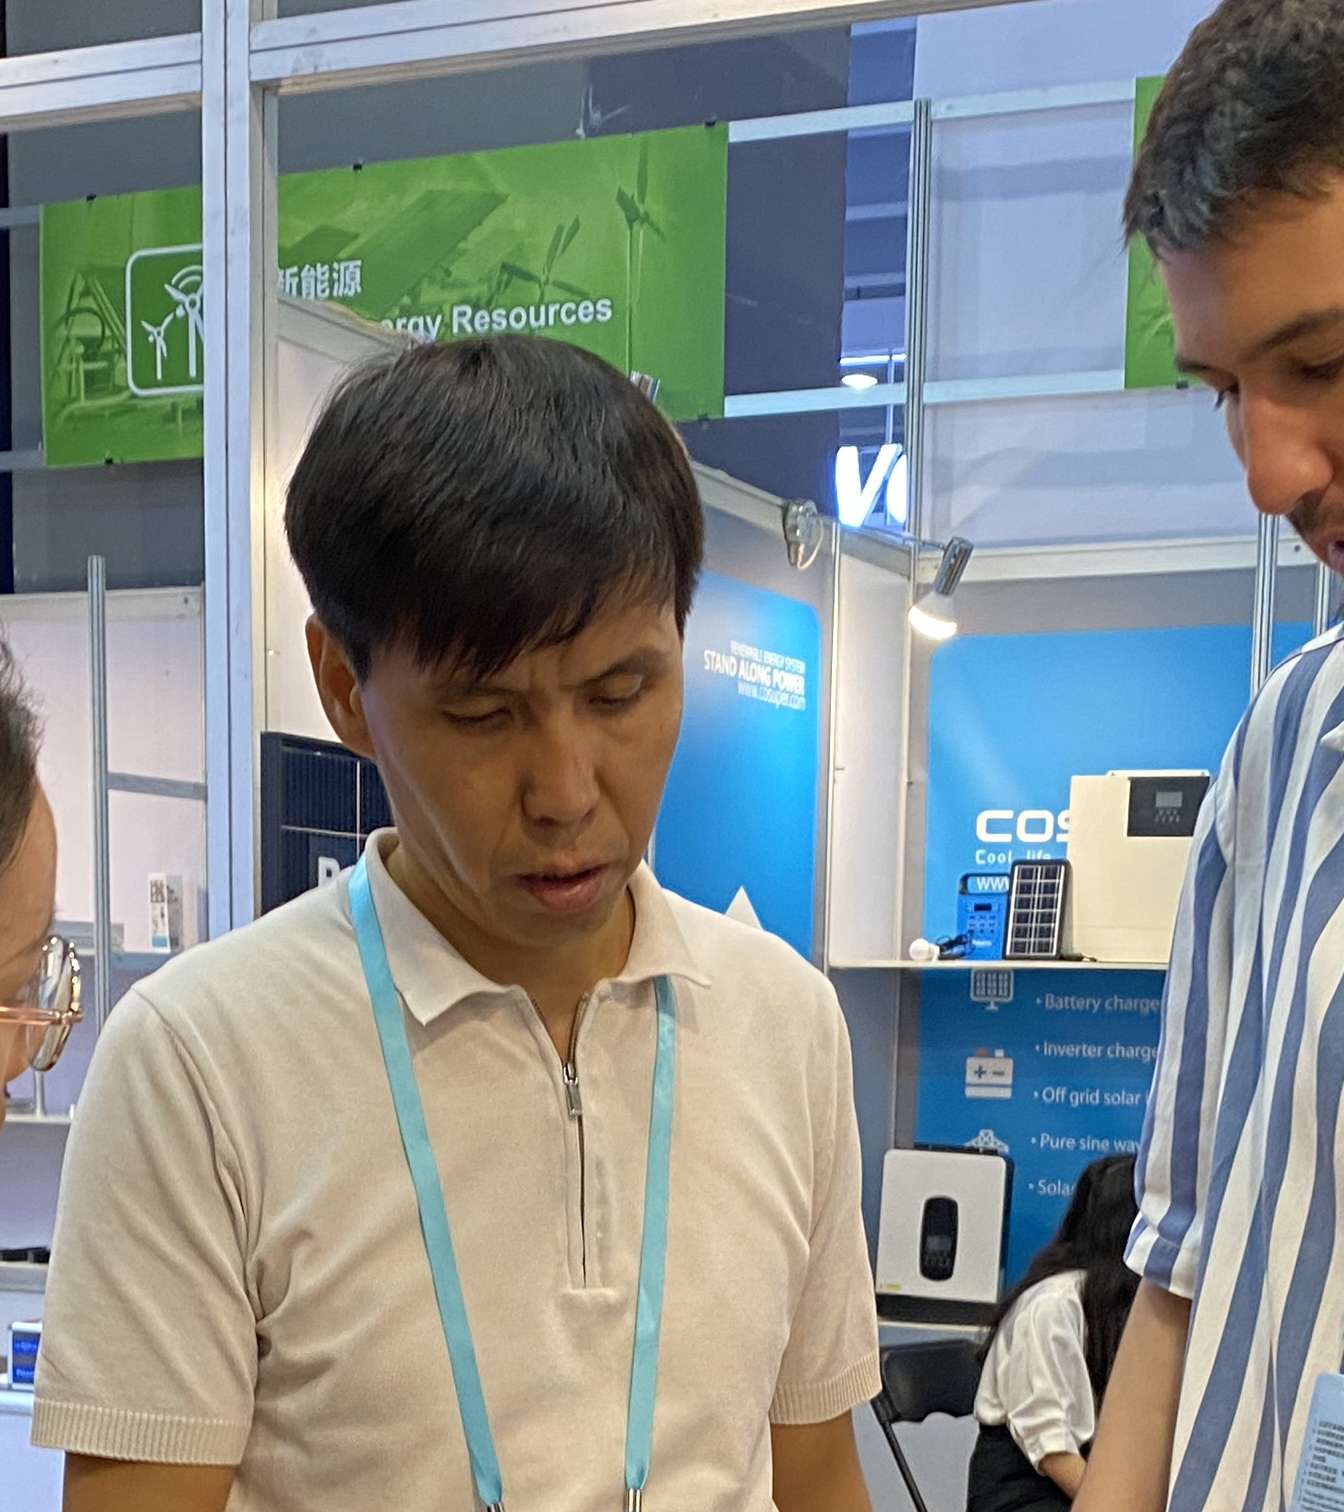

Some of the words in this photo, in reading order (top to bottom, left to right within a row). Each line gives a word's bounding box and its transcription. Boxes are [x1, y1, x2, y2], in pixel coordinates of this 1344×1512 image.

[452, 298, 613, 336] Resources
[1045, 993, 1100, 1013] Battery
[1043, 1040, 1103, 1057] Inverter
[1042, 1086, 1065, 1103] Off
[1069, 1089, 1100, 1108] grid
[1104, 1092, 1141, 1106] solar
[1040, 1133, 1076, 1149] Pure
[1079, 1135, 1110, 1151] sine
